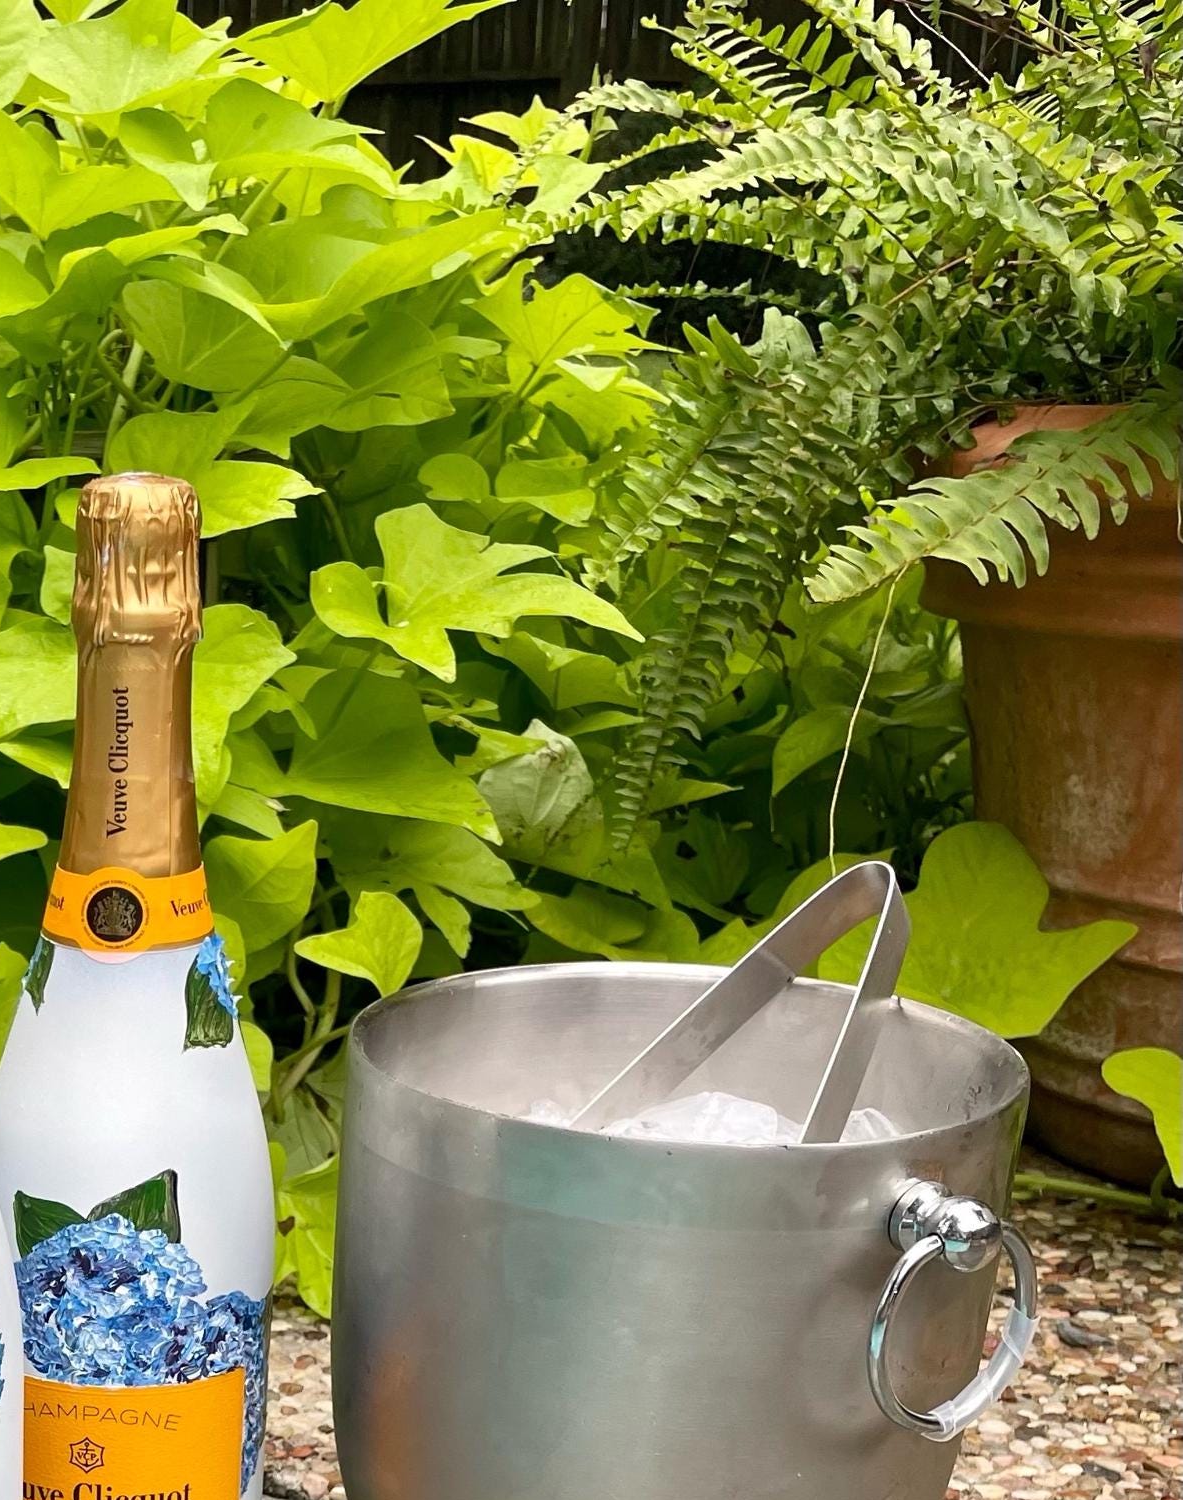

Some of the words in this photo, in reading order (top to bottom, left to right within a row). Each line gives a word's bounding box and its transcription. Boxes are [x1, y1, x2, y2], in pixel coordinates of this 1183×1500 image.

[107, 686, 134, 773] Clicquot
[106, 778, 127, 839] Veuve
[170, 895, 204, 918] Veuve
[23, 1402, 183, 1432] HAMPAGNE
[76, 1451, 98, 1461] VCP
